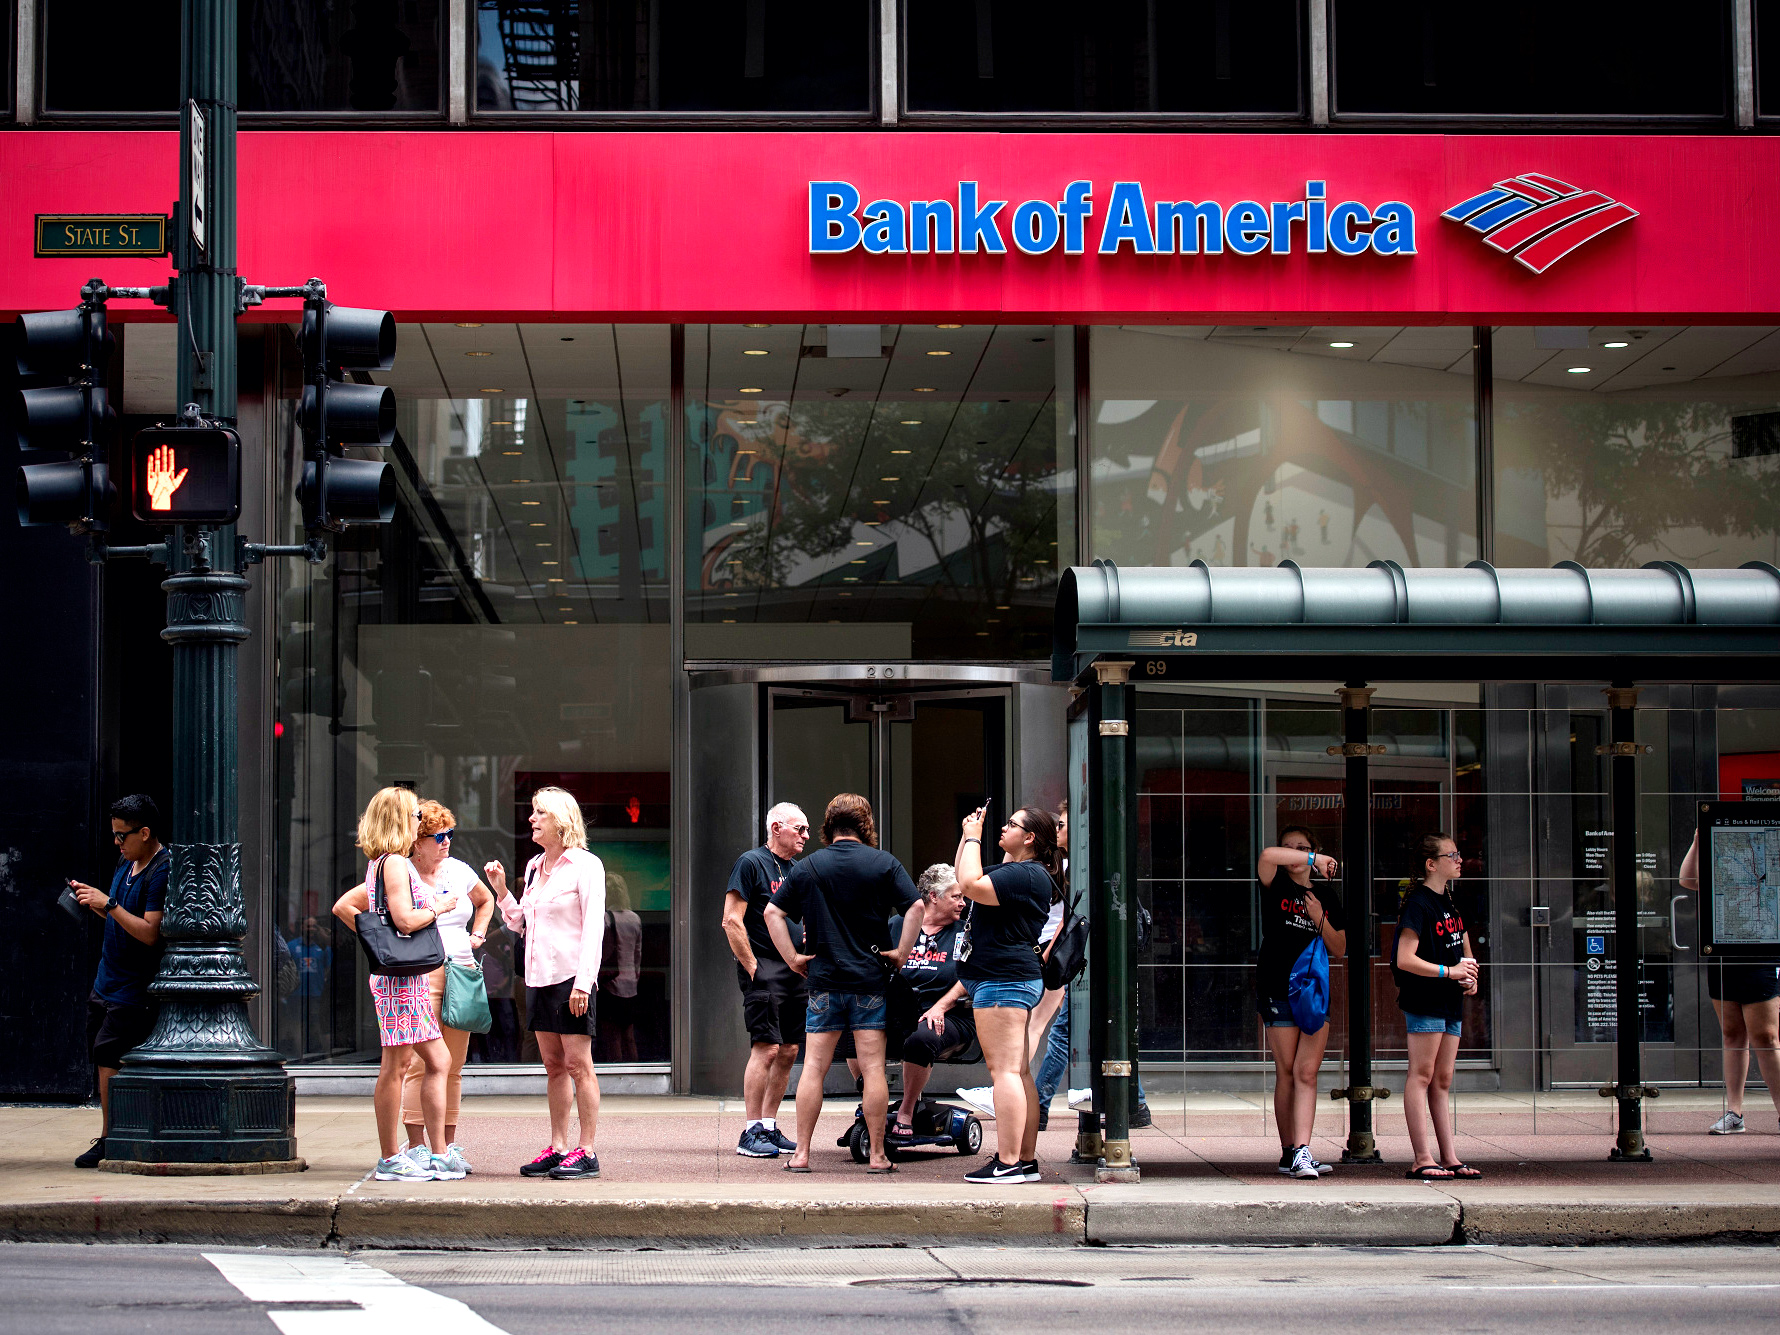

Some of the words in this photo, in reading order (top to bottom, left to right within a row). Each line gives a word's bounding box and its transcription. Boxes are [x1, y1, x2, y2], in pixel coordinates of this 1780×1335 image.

[808, 179, 1007, 255] Bank
[1011, 179, 1093, 255] of
[1097, 179, 1419, 255] America
[64, 224, 111, 246] STATE
[118, 224, 142, 246] ST.
[1159, 629, 1198, 647] cta
[1146, 660, 1167, 675] 69
[1745, 786, 1780, 796] Welcom
